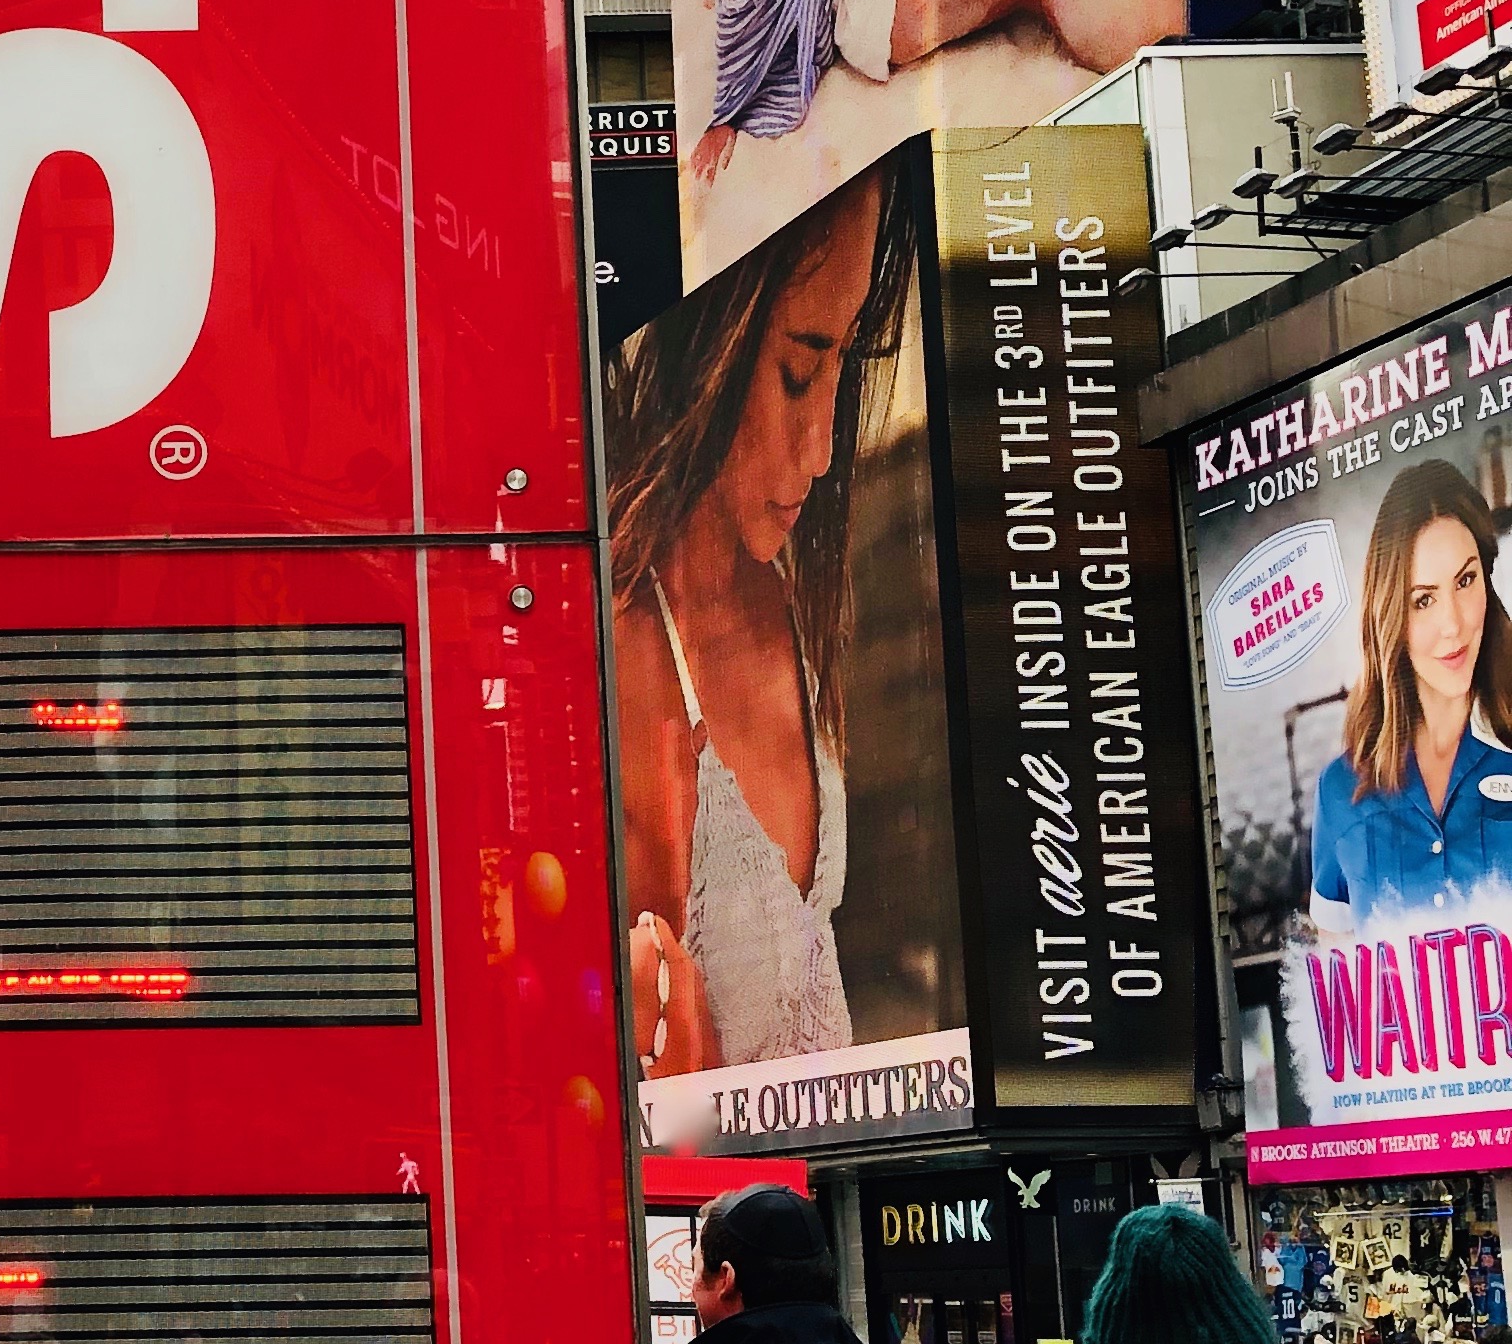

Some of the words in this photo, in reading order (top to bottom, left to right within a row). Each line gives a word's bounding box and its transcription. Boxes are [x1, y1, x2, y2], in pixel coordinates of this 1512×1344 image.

[1436, 5, 1484, 43] American
[588, 110, 676, 131] RIOT
[982, 161, 1039, 287] LEVEL
[993, 304, 1044, 370] 3RD
[1054, 215, 1125, 493] OUTFITTERS
[997, 386, 1052, 473] THE
[1196, 335, 1452, 492] KATHARINE
[1244, 456, 1321, 514] JOINS
[1326, 429, 1382, 481] THE
[1389, 394, 1466, 455] CAST
[1004, 491, 1059, 553] ON
[1076, 510, 1137, 650] EAGLE
[1228, 570, 1269, 606] ORIGINAL
[1268, 550, 1296, 579] MUSIC
[1297, 541, 1309, 557] BY
[1250, 574, 1296, 618] SARA
[1010, 569, 1071, 730] INSIDE
[1233, 582, 1325, 659] BAREILLES
[1088, 671, 1159, 922] AMERICAN
[1006, 752, 1086, 918] aerie
[1036, 927, 1095, 1061] VISIT
[1108, 939, 1164, 998] OF
[757, 1055, 972, 1134] OUTFITTERS
[1333, 1091, 1365, 1110] NOW
[1366, 1086, 1418, 1108] PLAYING
[1421, 1085, 1437, 1101] AT
[1440, 1082, 1465, 1100] THE
[1261, 1141, 1308, 1164] BROOKS
[1311, 1136, 1377, 1160] ATKINSON
[1380, 1132, 1440, 1154] THEATRE
[1451, 1129, 1476, 1150] 256
[882, 1198, 992, 1246] DRINK
[1073, 1197, 1116, 1214] DRINK
[1342, 1222, 1355, 1240] 4
[1282, 1298, 1296, 1320] 10
[1348, 1285, 1359, 1303] 5
